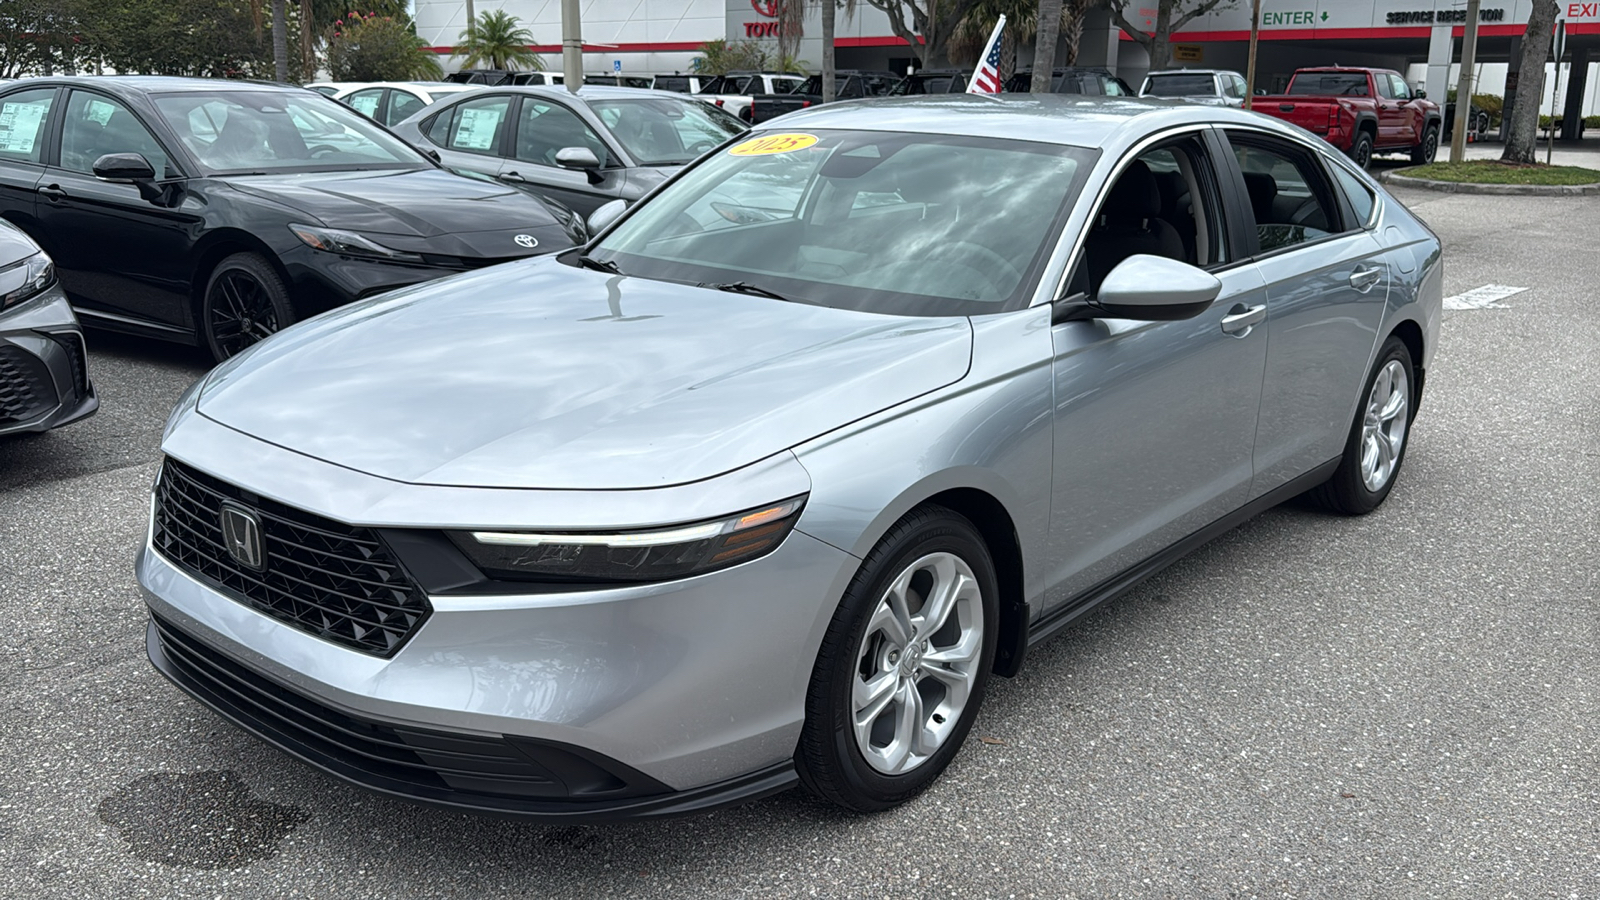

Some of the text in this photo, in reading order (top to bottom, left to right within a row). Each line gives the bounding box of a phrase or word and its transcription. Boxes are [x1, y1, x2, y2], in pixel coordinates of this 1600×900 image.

[1386, 8, 1504, 24] SERVICE RECEION
[1567, 3, 1600, 17] EXI
[1263, 11, 1314, 25] ENTER
[737, 137, 809, 153] 2025
